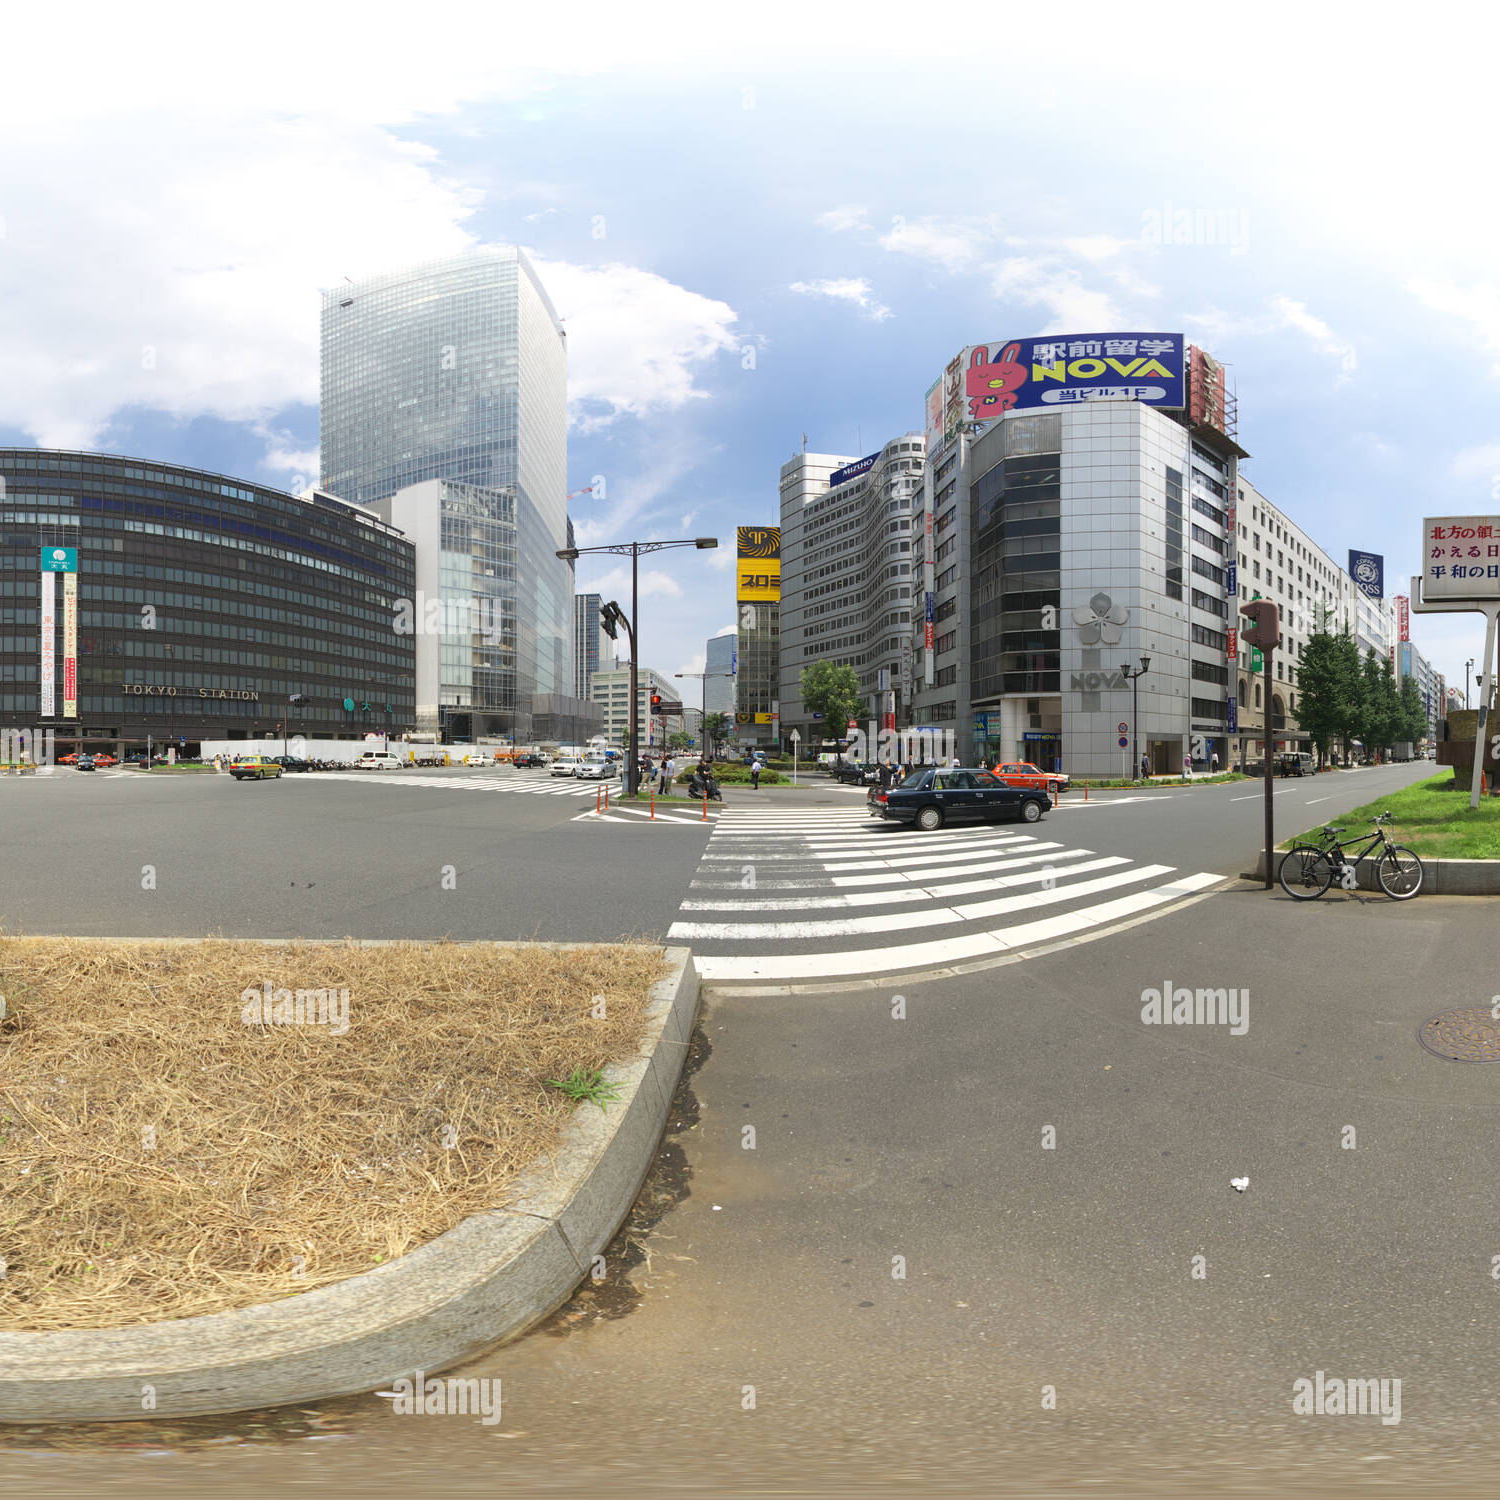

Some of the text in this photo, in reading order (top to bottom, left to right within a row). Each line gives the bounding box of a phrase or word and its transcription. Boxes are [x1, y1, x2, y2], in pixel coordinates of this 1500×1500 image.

[1032, 339, 1175, 360] 駅前留学
[1032, 358, 1176, 384] NOVA
[842, 459, 873, 476] MIZUHO
[1430, 564, 1499, 579] 平和の日
[1071, 672, 1131, 690] NOVA
[123, 684, 259, 701] TOKYO STATION
